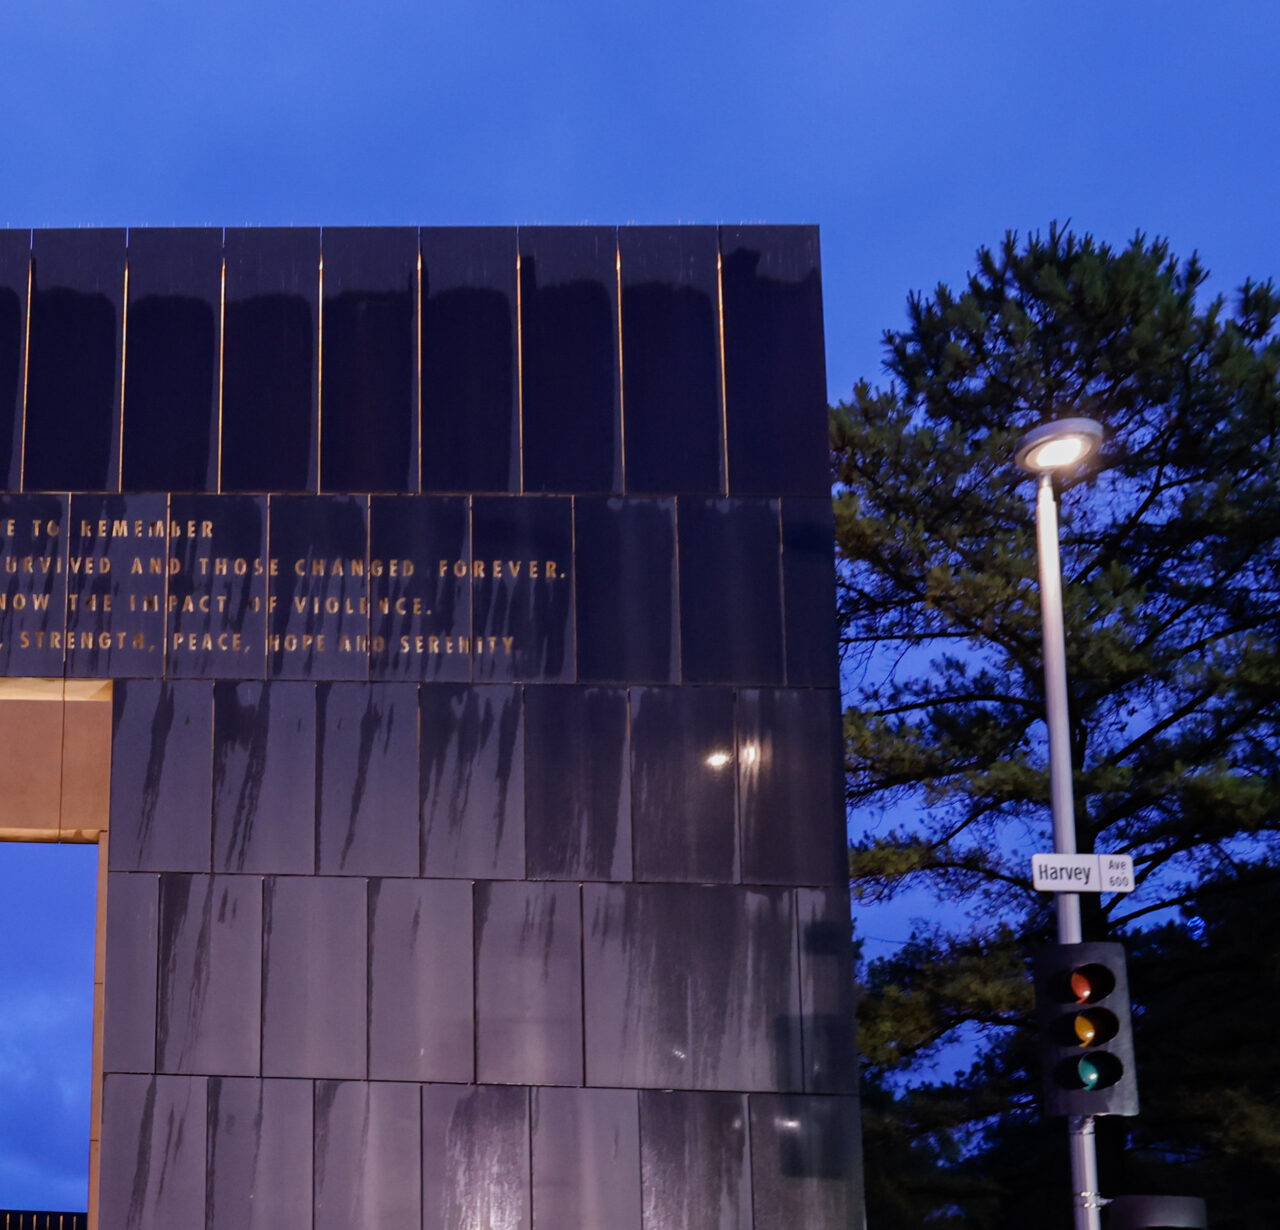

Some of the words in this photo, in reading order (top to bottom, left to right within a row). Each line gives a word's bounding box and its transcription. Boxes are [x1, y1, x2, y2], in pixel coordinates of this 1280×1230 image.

[32, 520, 60, 537] TO
[81, 520, 213, 539] REMEMBER
[131, 557, 181, 575] AND
[199, 557, 279, 576] THOSE
[294, 558, 415, 577] CHANGED
[439, 559, 566, 579] FOREVER.
[68, 594, 112, 612] THE
[129, 594, 227, 613] IMPACT
[248, 596, 277, 614] OF
[294, 596, 432, 615] VIOLENCE.
[20, 631, 157, 652] STRENGTH,
[173, 632, 250, 653] PEACE,
[266, 633, 325, 652] HOPE
[340, 635, 385, 653] AND
[1038, 863, 1091, 885] Harvey
[1108, 859, 1126, 870] Ave
[1109, 875, 1128, 887] 600
